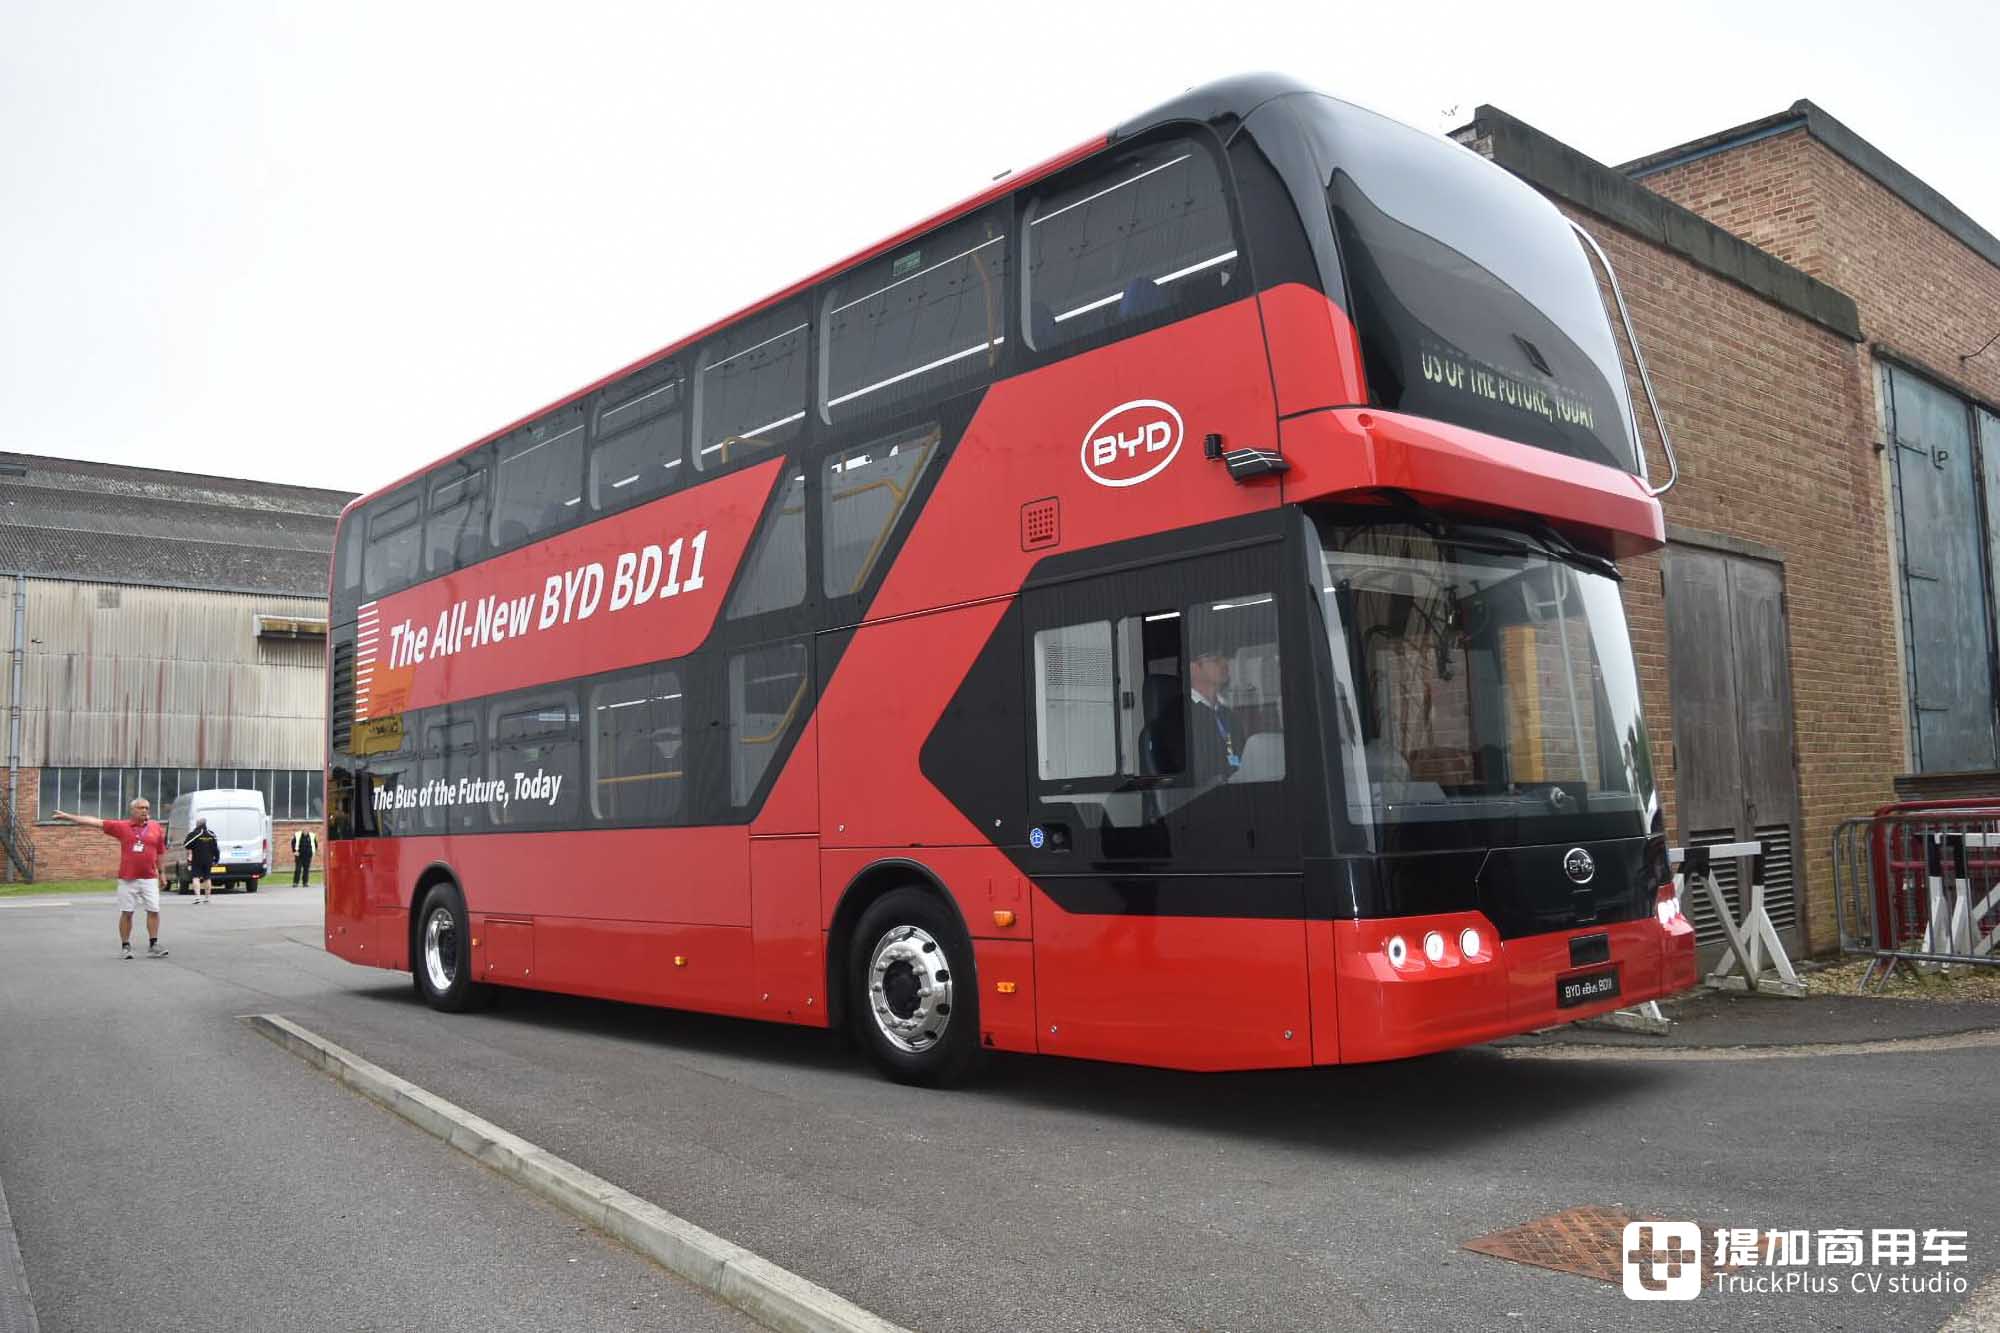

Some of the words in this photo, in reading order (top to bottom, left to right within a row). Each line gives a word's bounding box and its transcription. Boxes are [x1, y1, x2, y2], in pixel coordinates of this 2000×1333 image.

[1093, 420, 1171, 466] BYD
[389, 619, 428, 670] The
[431, 593, 536, 660] All-New
[539, 562, 605, 630] BYD
[609, 530, 708, 611] BD11
[372, 785, 393, 811] The
[395, 784, 417, 808] Bus
[419, 781, 435, 806] of
[434, 778, 457, 805] the
[458, 775, 510, 808] Future,
[514, 768, 562, 805] Today
